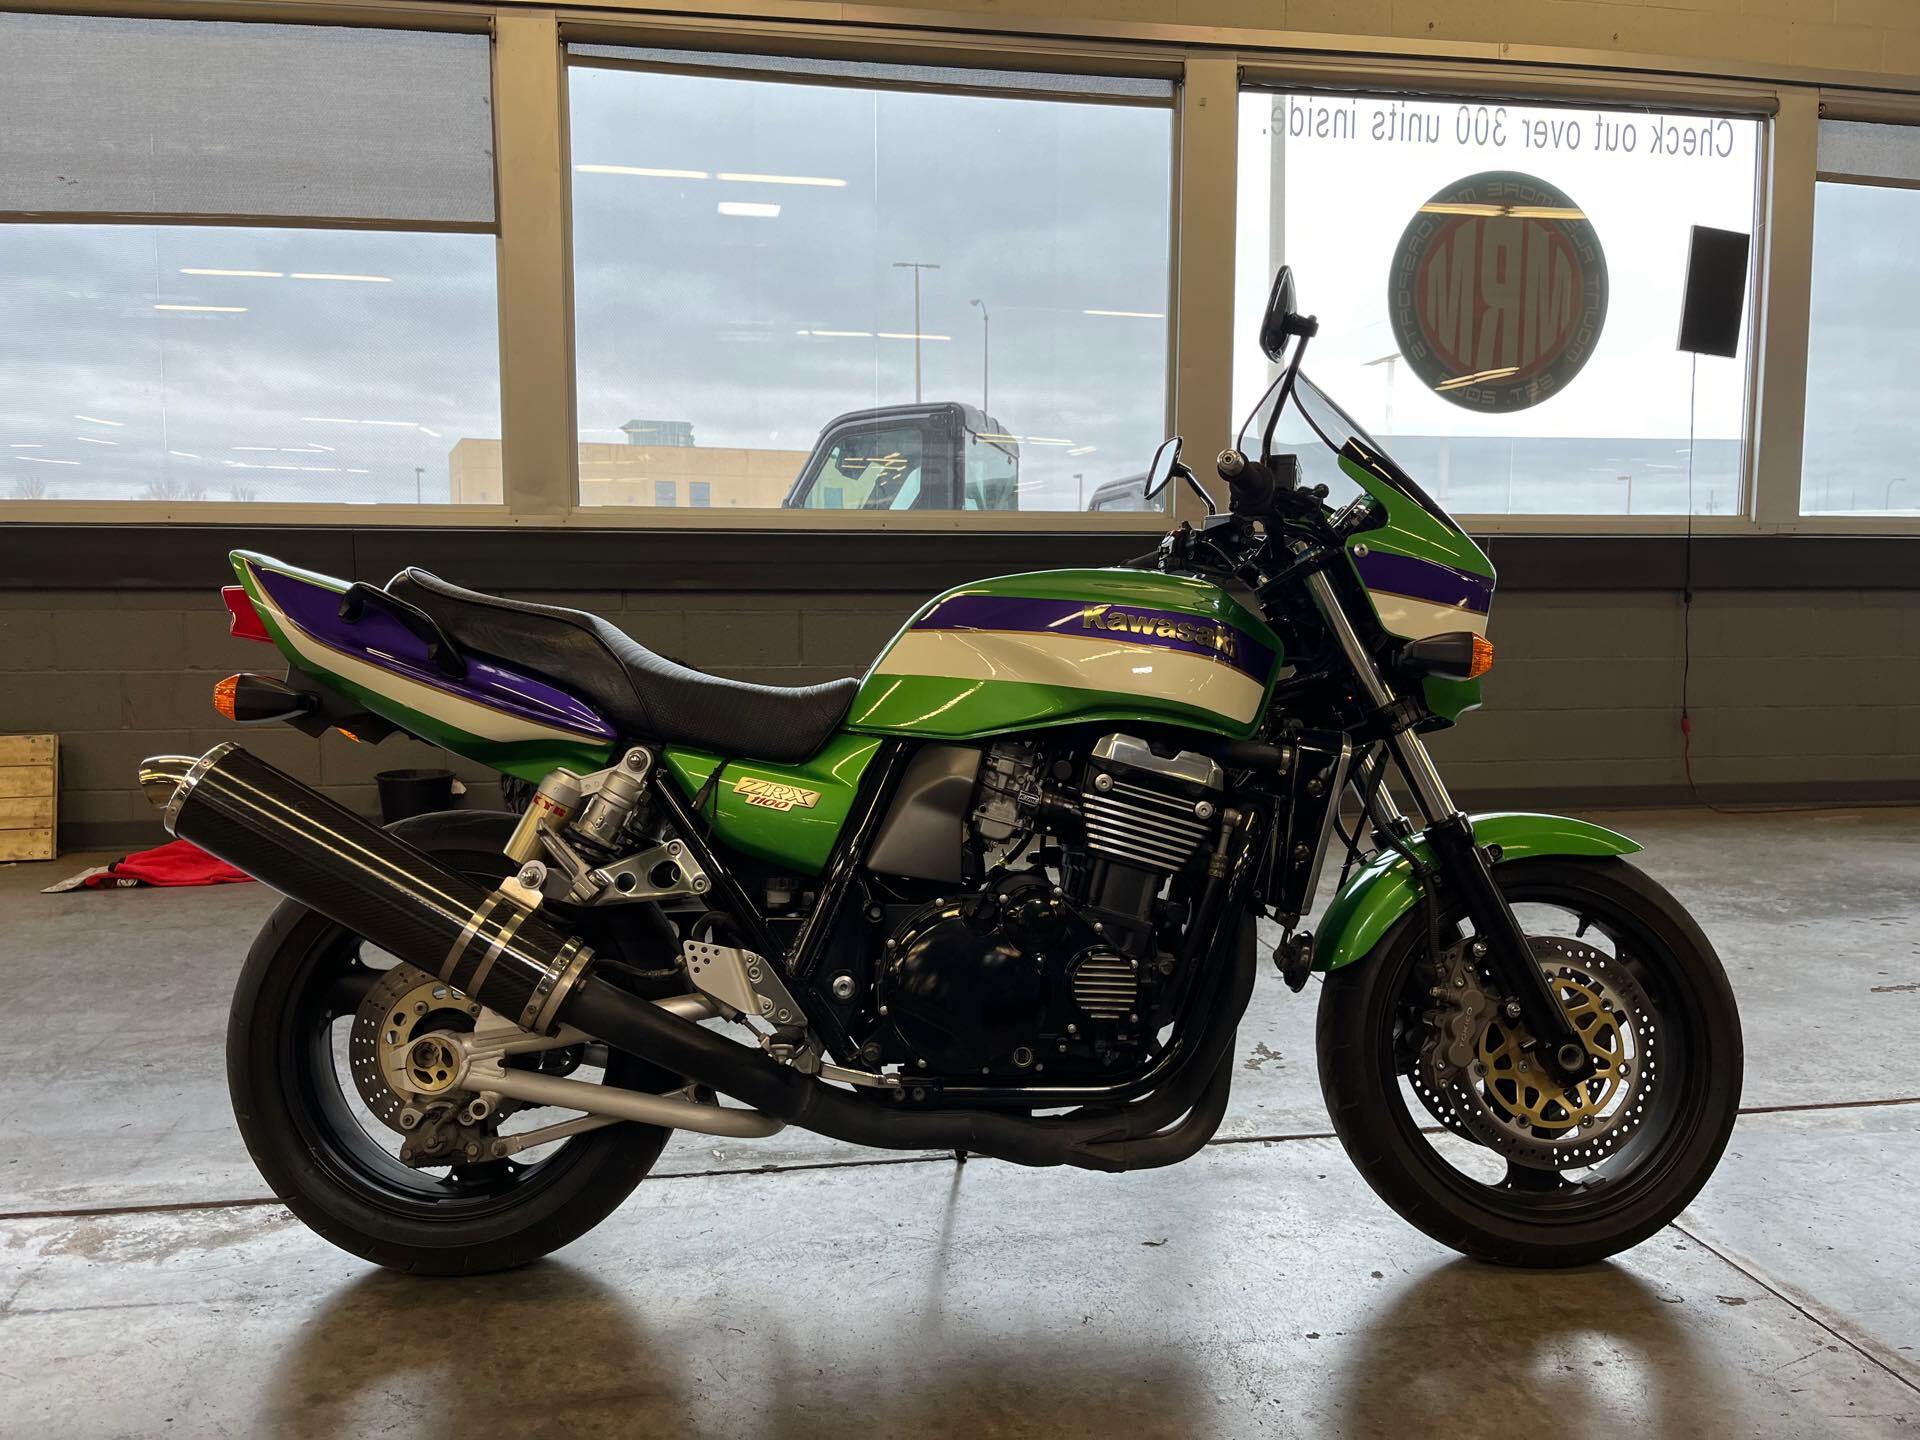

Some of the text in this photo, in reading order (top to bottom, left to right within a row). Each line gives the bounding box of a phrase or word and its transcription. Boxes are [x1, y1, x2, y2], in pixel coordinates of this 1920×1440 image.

[1082, 605, 1237, 658] Kawasaki
[738, 779, 815, 806] ZRX
[750, 796, 790, 810] 1100
